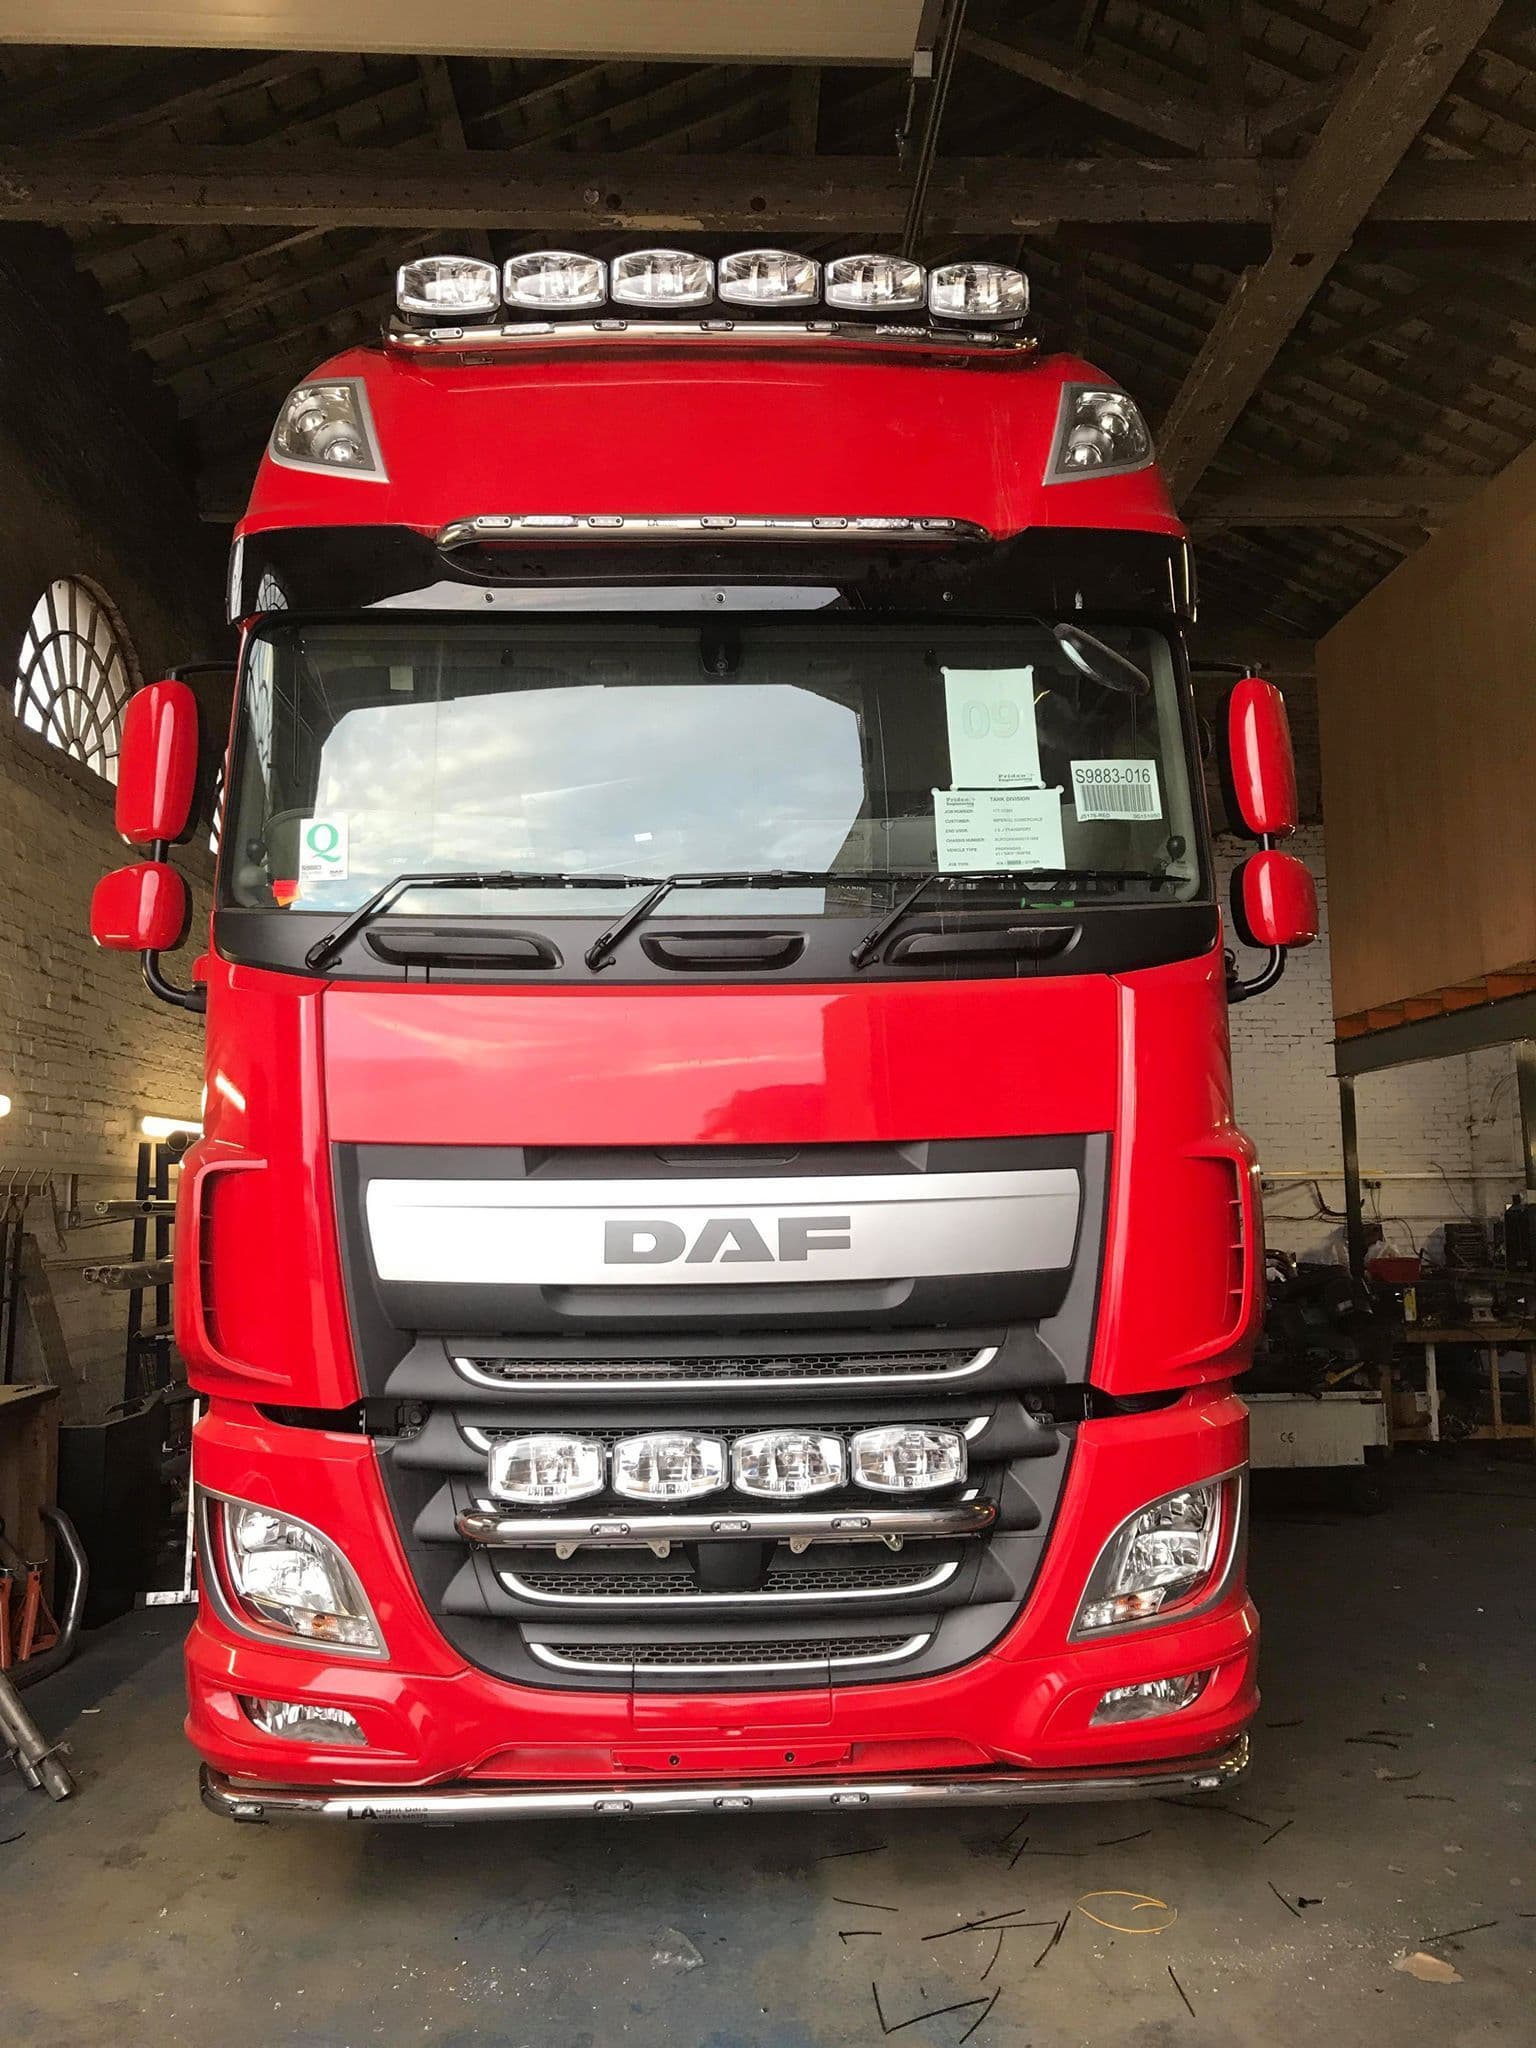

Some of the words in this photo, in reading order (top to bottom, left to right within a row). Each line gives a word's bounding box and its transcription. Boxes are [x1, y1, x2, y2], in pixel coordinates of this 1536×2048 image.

[961, 700, 1020, 739] 09
[1075, 768, 1151, 783] S9883-016
[306, 823, 342, 863] Q
[604, 1216, 851, 1264] DAF
[347, 1805, 378, 1820] LA
